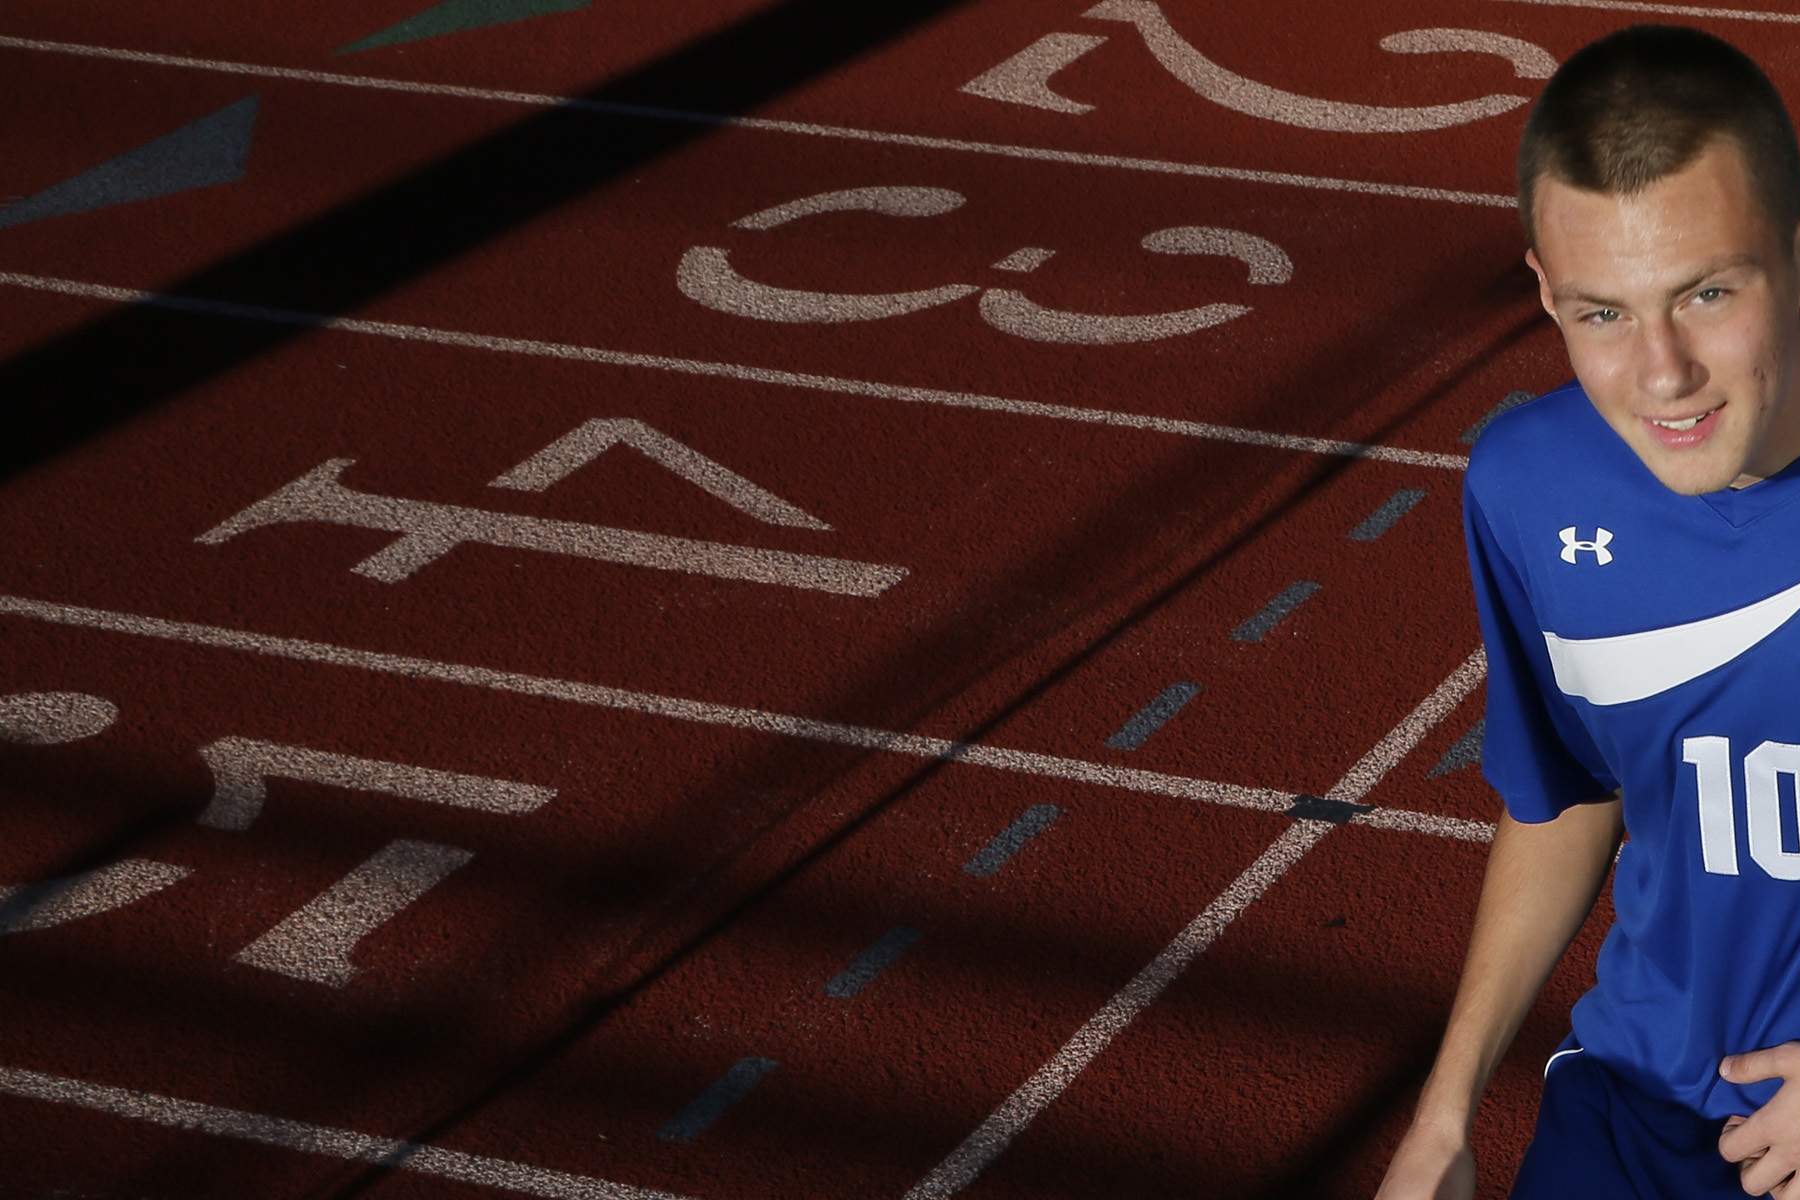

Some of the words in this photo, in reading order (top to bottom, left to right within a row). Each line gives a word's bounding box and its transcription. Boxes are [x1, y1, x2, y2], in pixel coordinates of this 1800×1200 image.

[957, 0, 1561, 133] 2
[676, 186, 1294, 345] 3
[193, 417, 910, 598] 4
